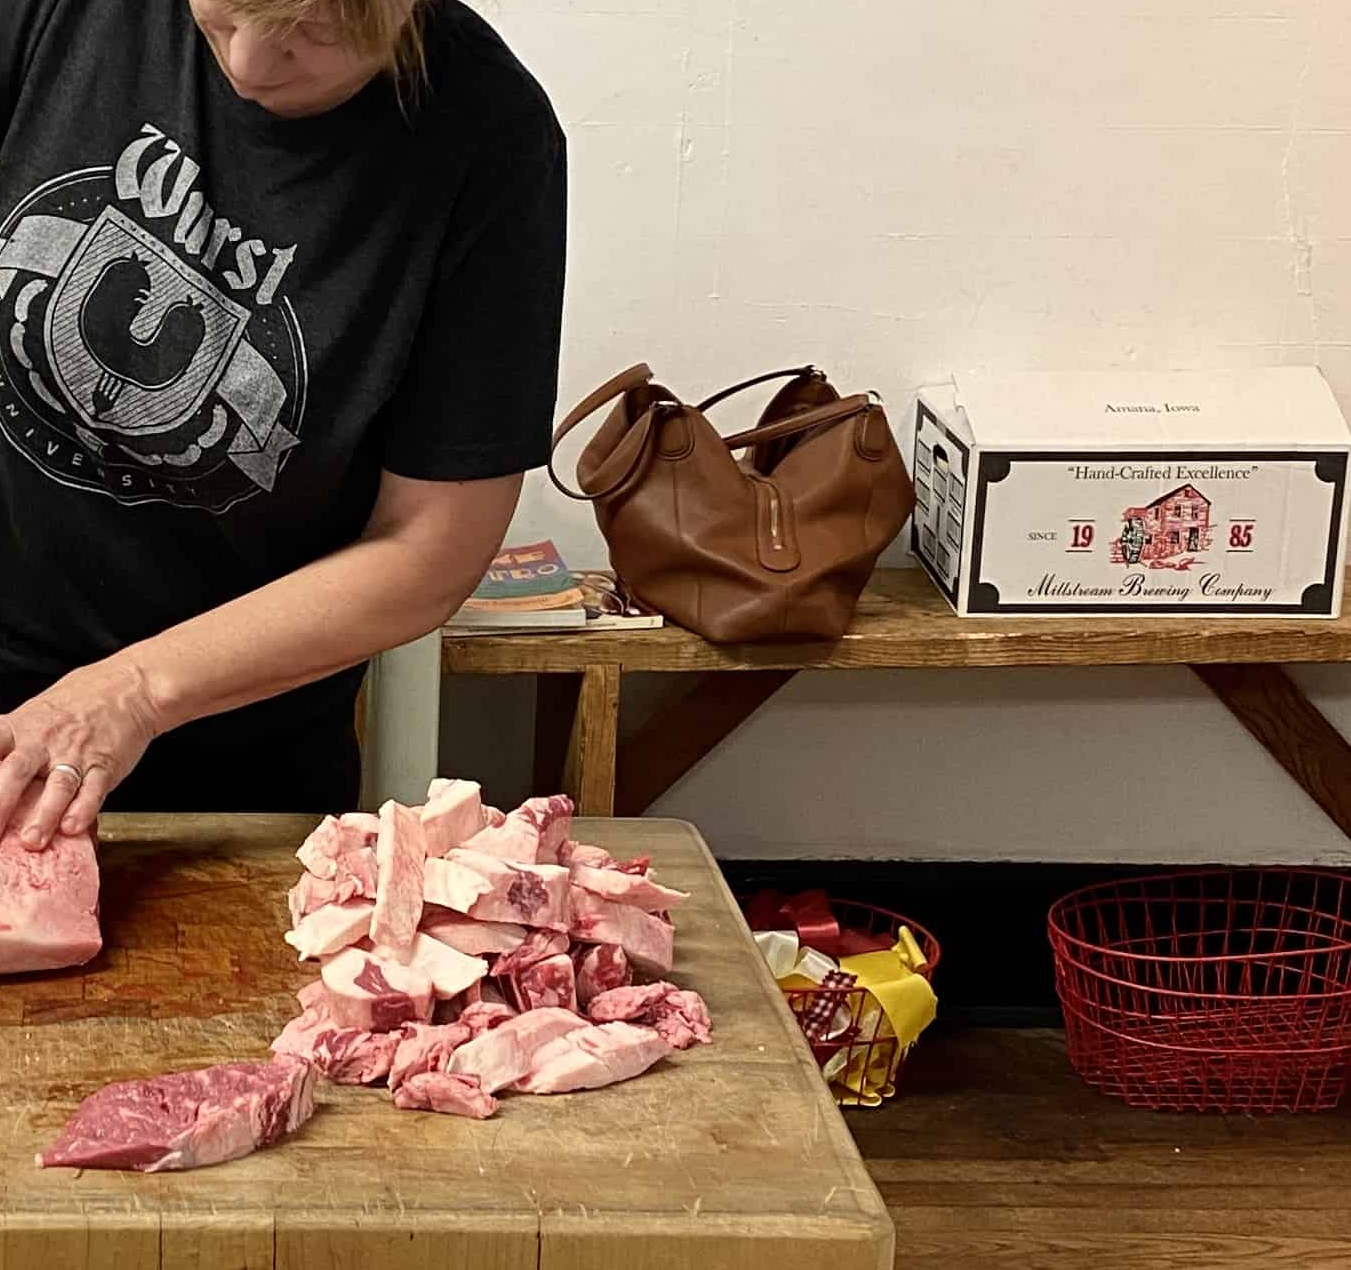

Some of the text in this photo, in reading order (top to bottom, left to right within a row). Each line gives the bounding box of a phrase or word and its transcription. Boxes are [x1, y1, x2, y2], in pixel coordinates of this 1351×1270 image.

[115, 123, 298, 305] Wurst
[1164, 403, 1201, 413] Iowa
[1027, 524, 1253, 548] SINCE 19 85
[1027, 573, 1273, 600] Millstream Brewing Company
